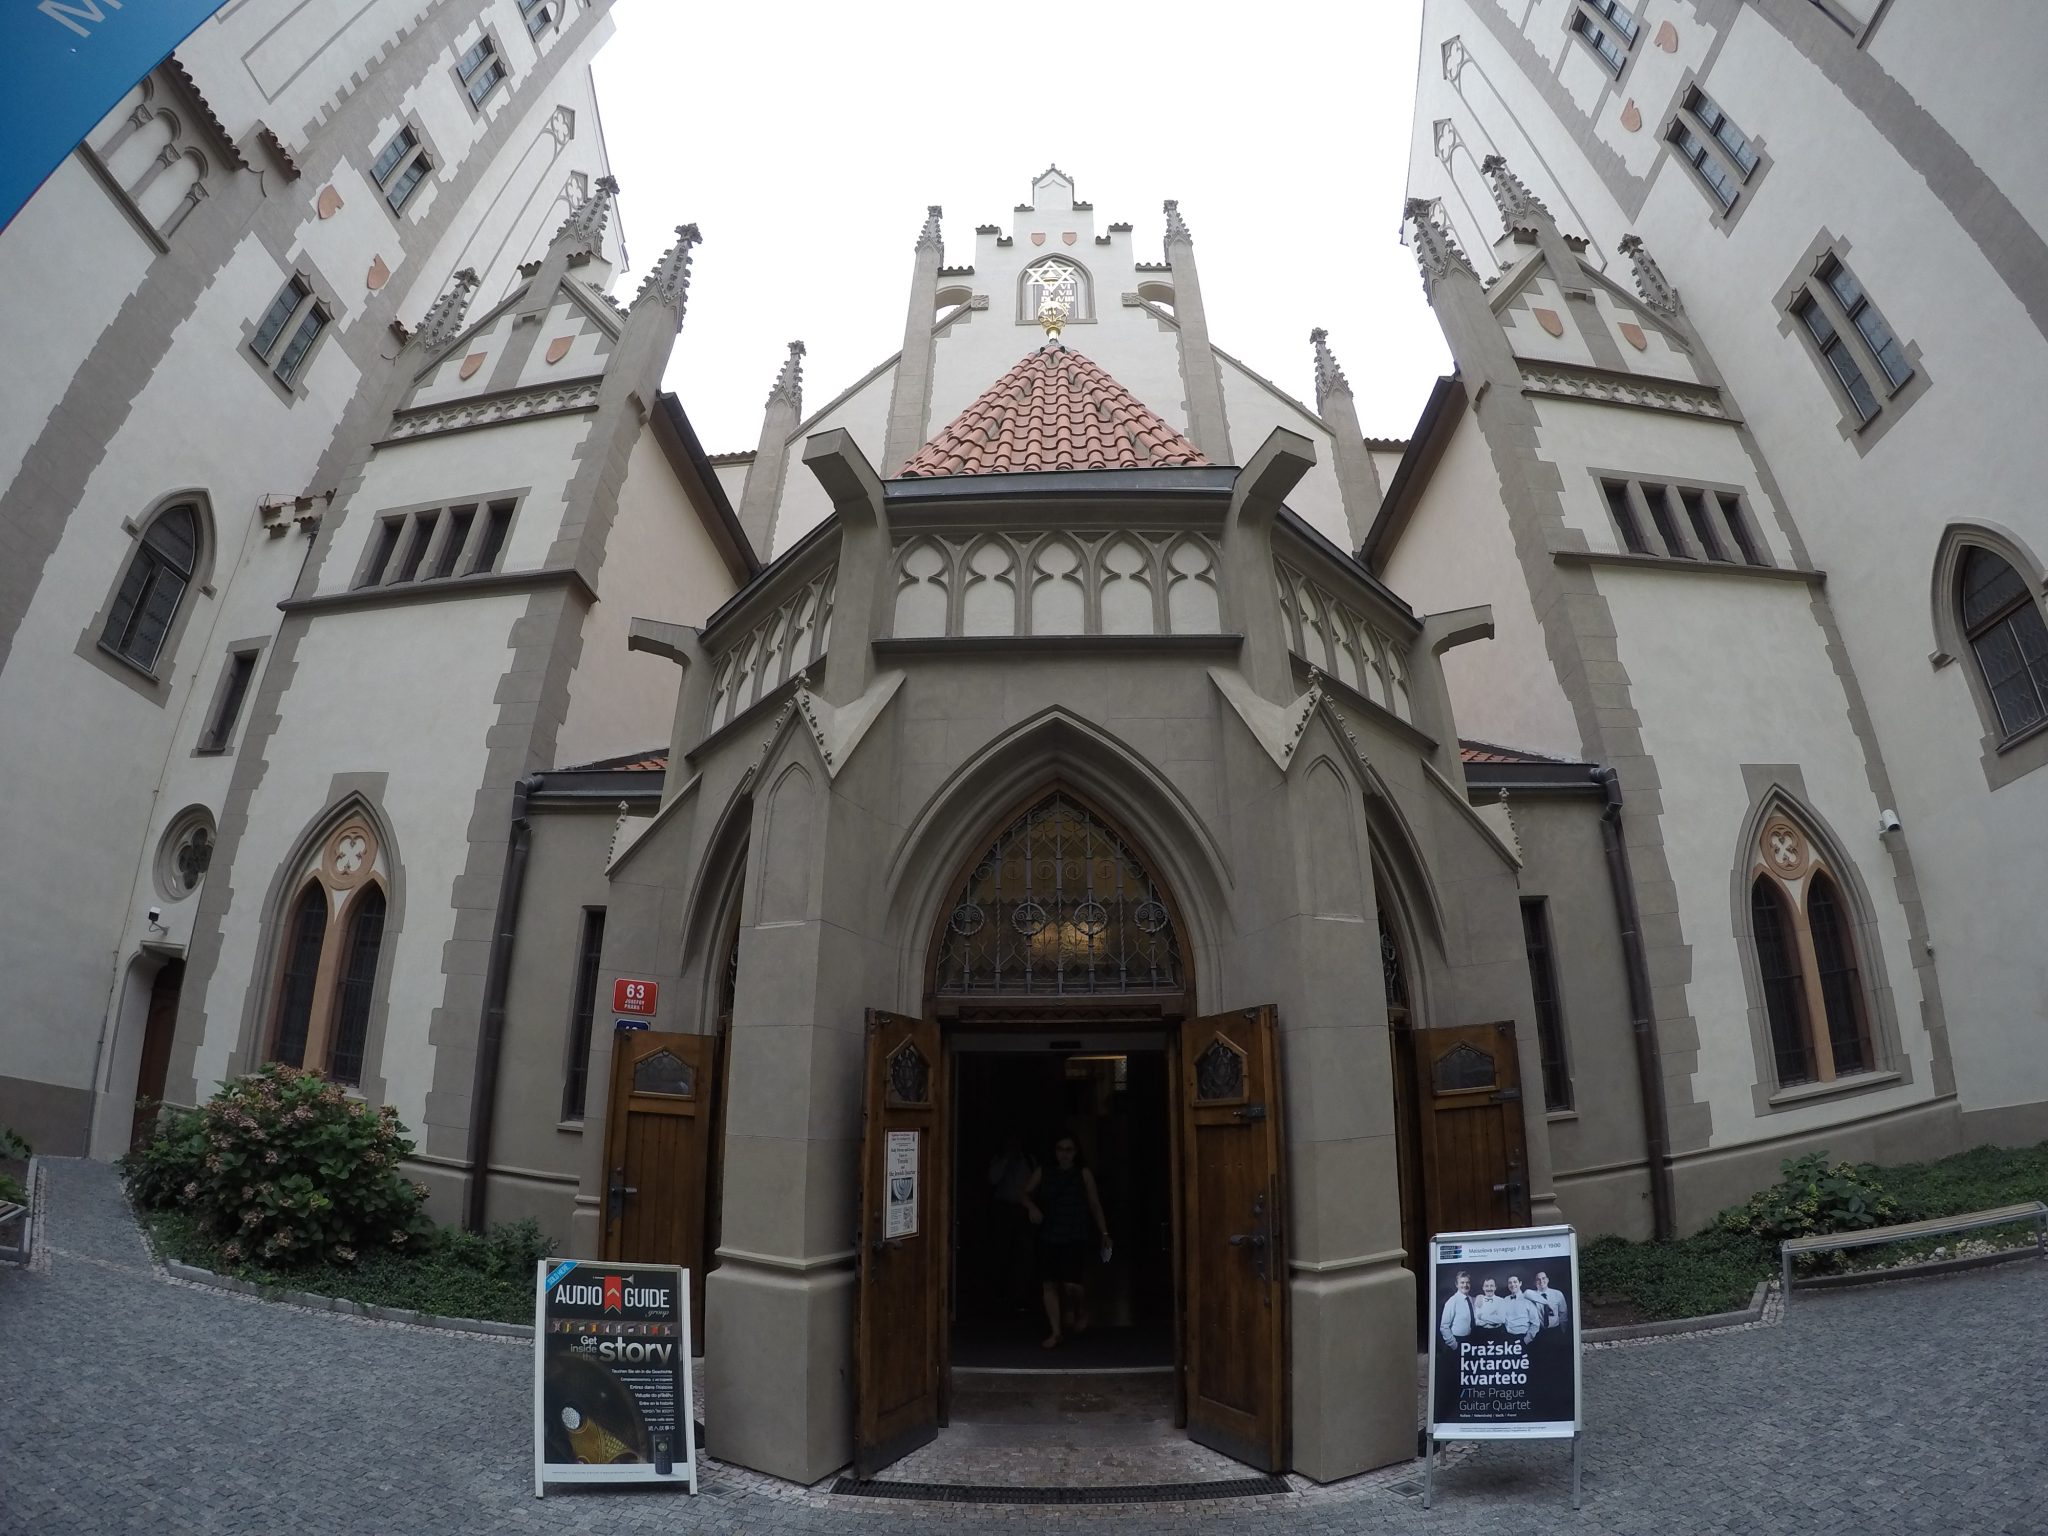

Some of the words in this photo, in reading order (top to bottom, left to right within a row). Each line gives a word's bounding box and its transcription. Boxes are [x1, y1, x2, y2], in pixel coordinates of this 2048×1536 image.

[627, 984, 645, 999] 63
[555, 1284, 603, 1306] AUDIO
[624, 1287, 670, 1308] GUIDE
[570, 1343, 598, 1353] inside
[580, 1335, 598, 1345] Get
[599, 1336, 673, 1364] story
[1460, 1340, 1522, 1356] Pražské
[1460, 1354, 1530, 1374] kytarové
[1460, 1371, 1527, 1385] kvarteto
[1488, 1388, 1525, 1400] Prague
[1459, 1400, 1489, 1411] Guitar
[1492, 1400, 1531, 1411] Quartet
